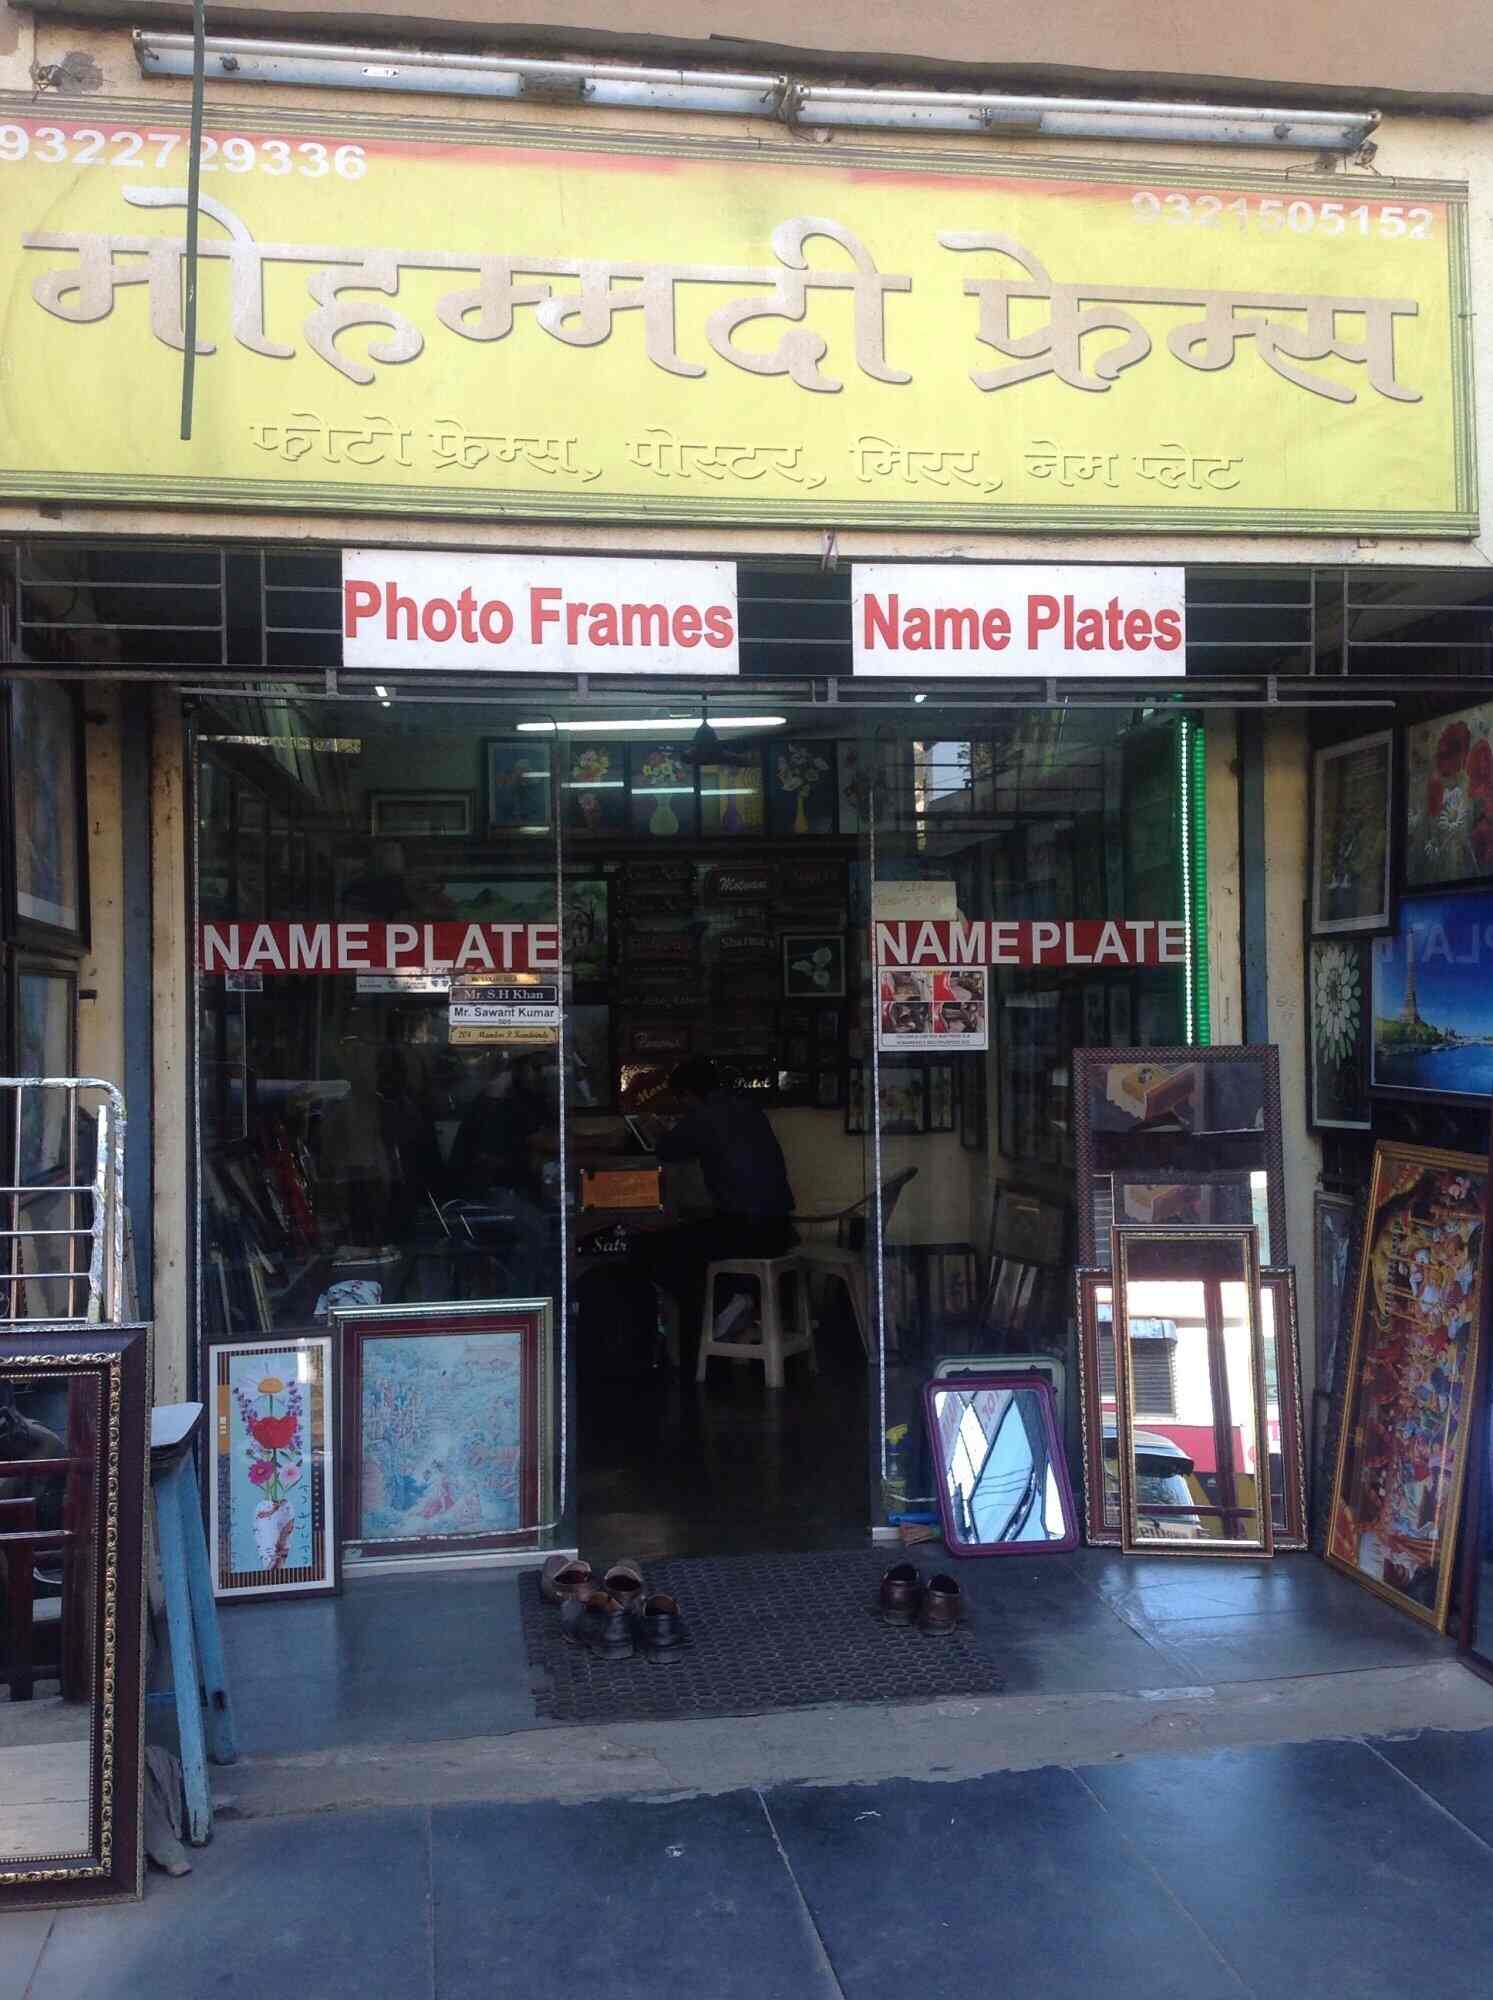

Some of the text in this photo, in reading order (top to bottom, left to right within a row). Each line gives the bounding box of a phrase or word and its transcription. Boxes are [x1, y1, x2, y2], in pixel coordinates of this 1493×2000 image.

[0, 124, 367, 180] 9322729336
[1131, 191, 1433, 240] 9321505152
[22, 186, 1423, 403] मोहम्मदी फ्रेम्स
[249, 411, 414, 466] फोटो
[848, 435, 1004, 494] मिरर,
[1024, 440, 1120, 488] नेम
[1132, 441, 1245, 490] प्लेट
[343, 579, 734, 648] Photo Frames
[864, 593, 1182, 651] Name Plates
[203, 923, 559, 970] NAME PLATE
[876, 920, 1187, 965] NAME PLATE
[454, 1007, 554, 1018] Mr. Sawant Kumar
[464, 990, 484, 1000] Mr.
[513, 990, 544, 1000] Khan
